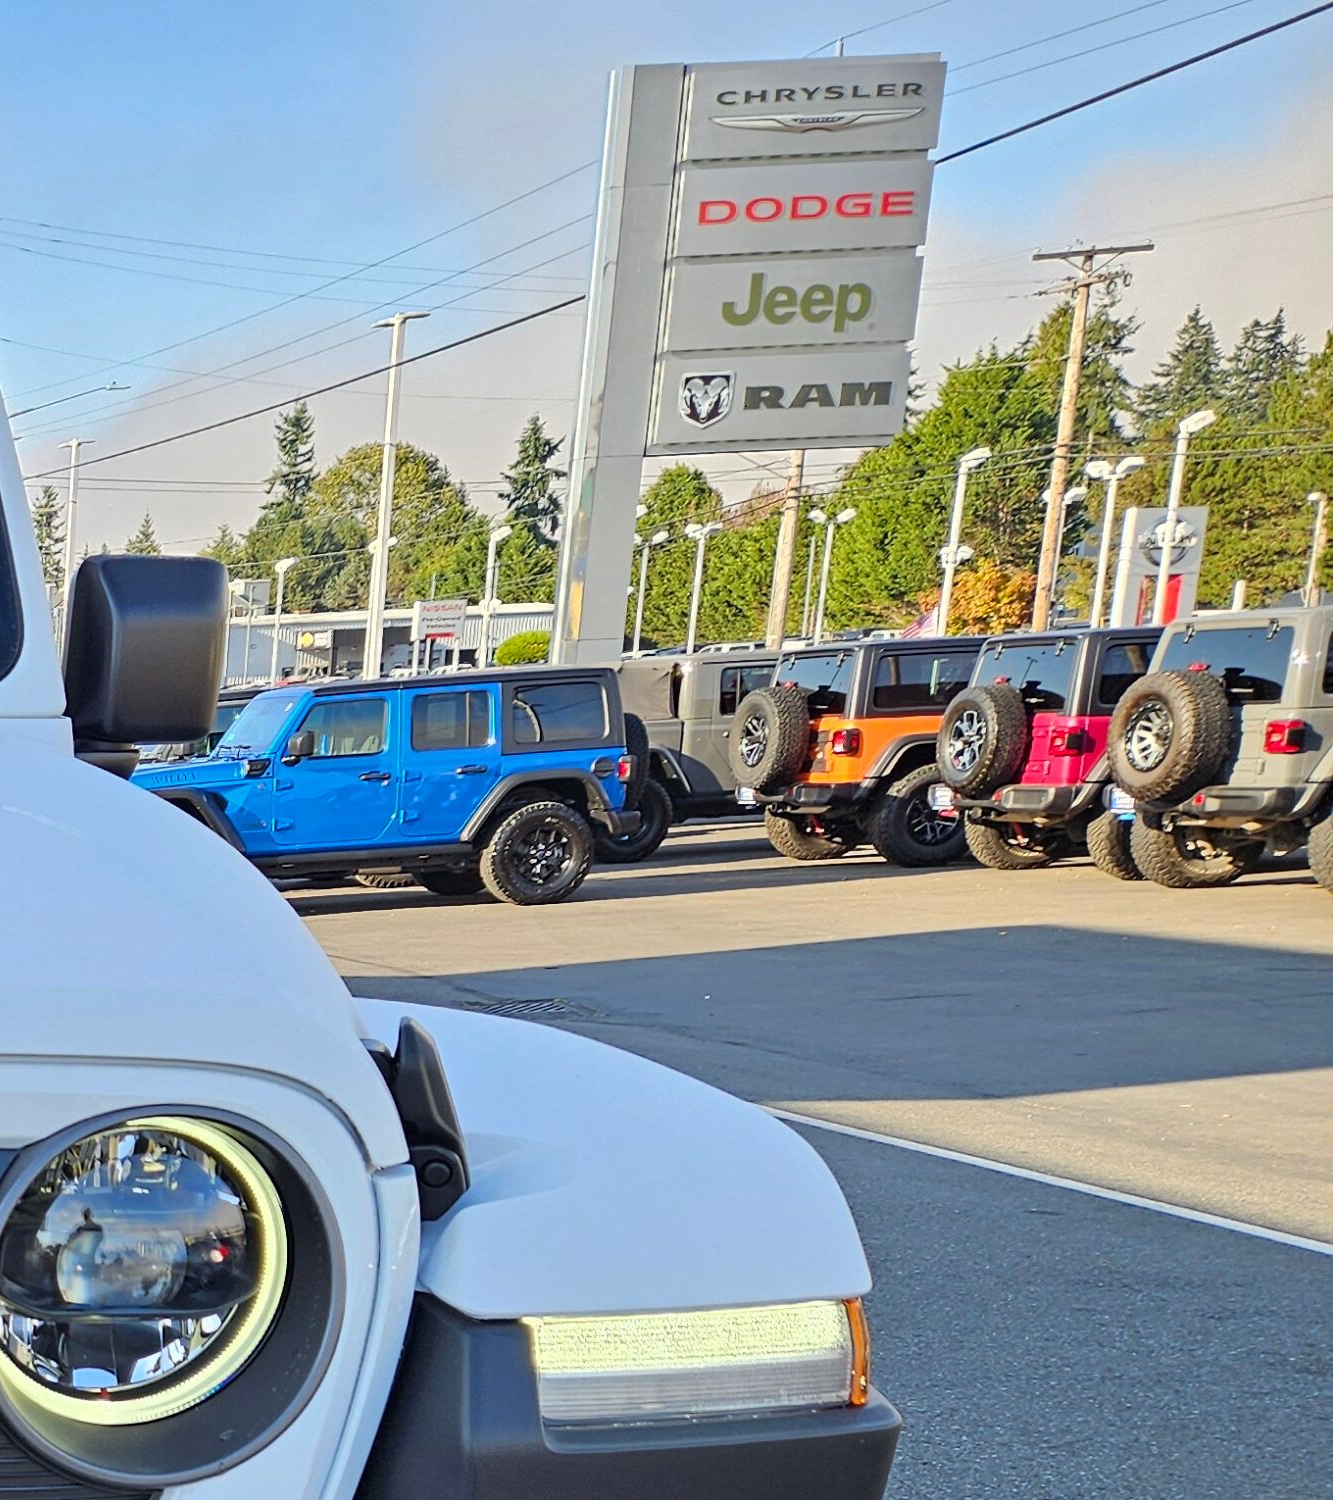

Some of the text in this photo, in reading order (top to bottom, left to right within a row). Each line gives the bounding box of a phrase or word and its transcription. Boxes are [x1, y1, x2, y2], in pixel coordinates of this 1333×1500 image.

[716, 82, 924, 106] CHRYSLER
[697, 190, 915, 226] DODGE
[721, 272, 872, 333] Jeep
[743, 381, 892, 411] RAM
[421, 603, 463, 613] NISSAN
